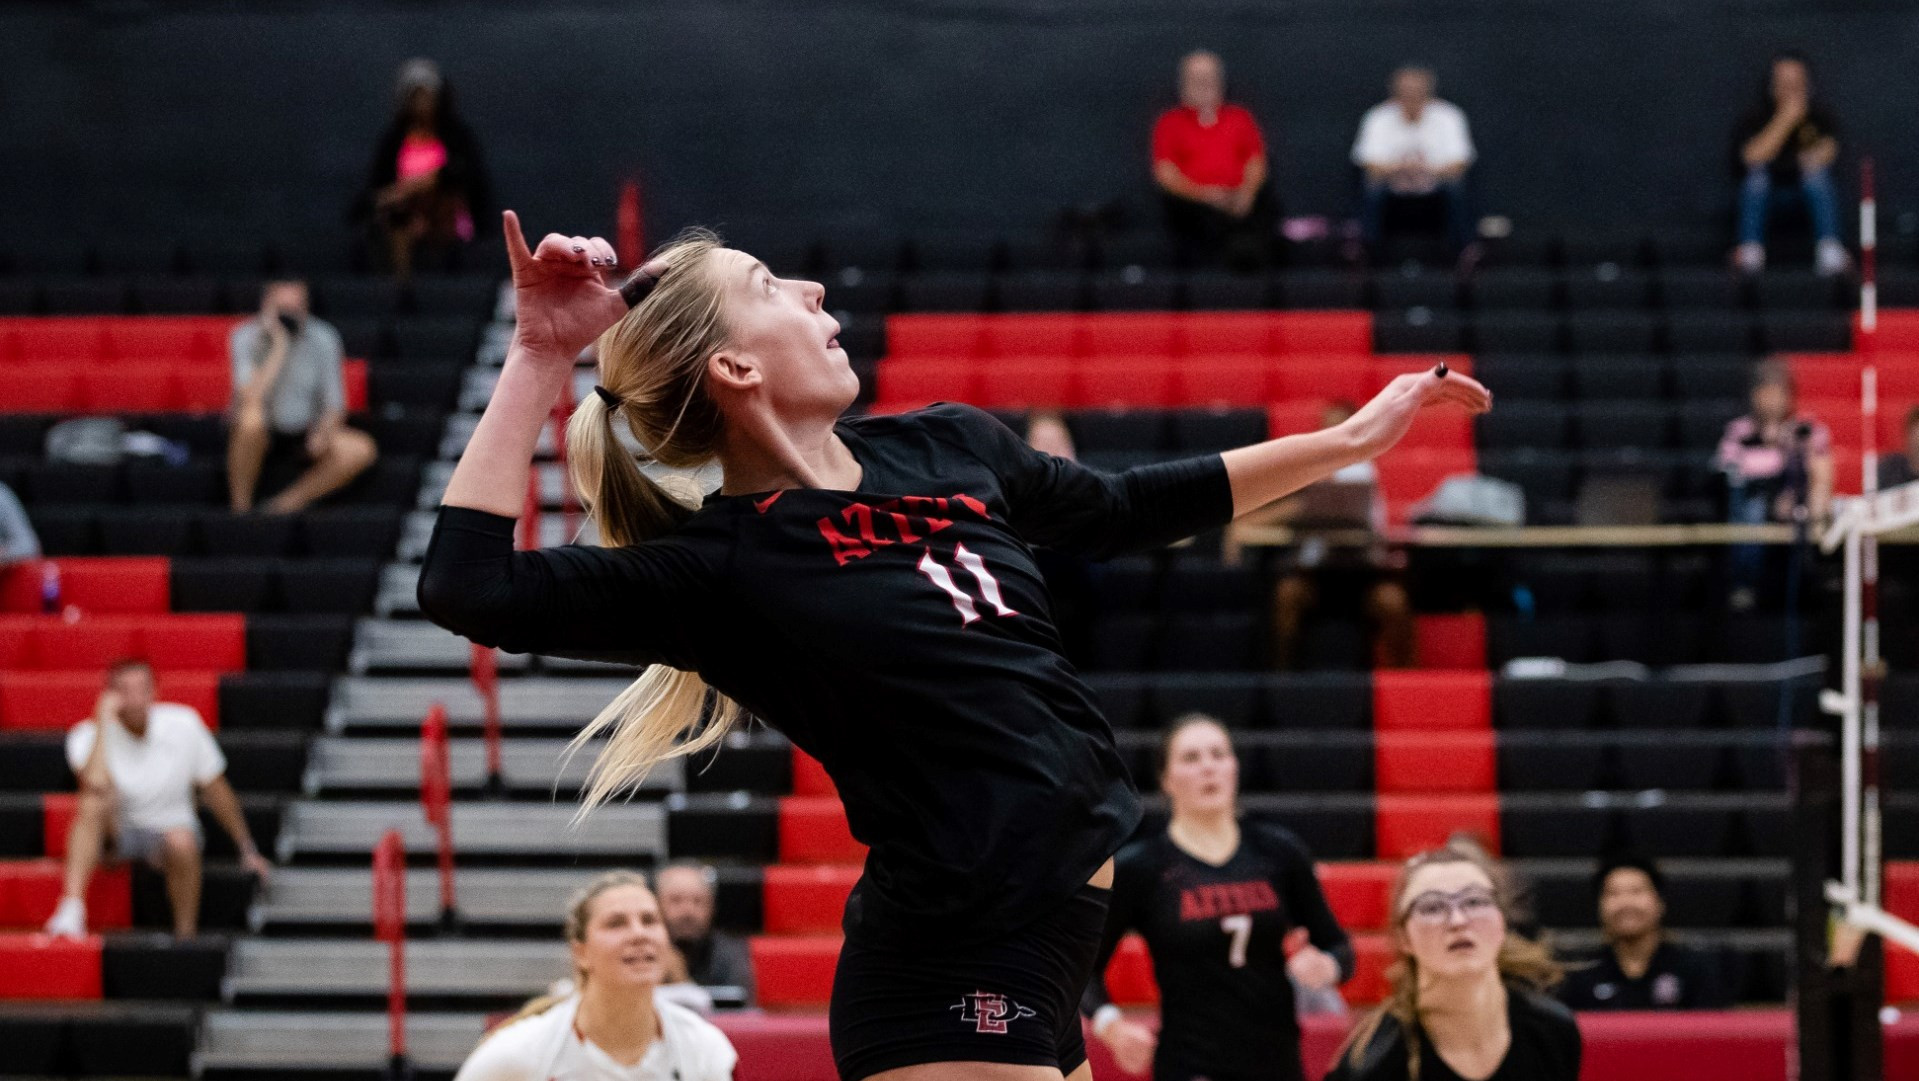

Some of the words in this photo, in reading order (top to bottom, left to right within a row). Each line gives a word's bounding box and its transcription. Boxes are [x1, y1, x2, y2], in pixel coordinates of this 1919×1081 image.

[817, 494, 991, 566] AZT
[916, 541, 1020, 630] 11
[1221, 914, 1253, 968] 7
